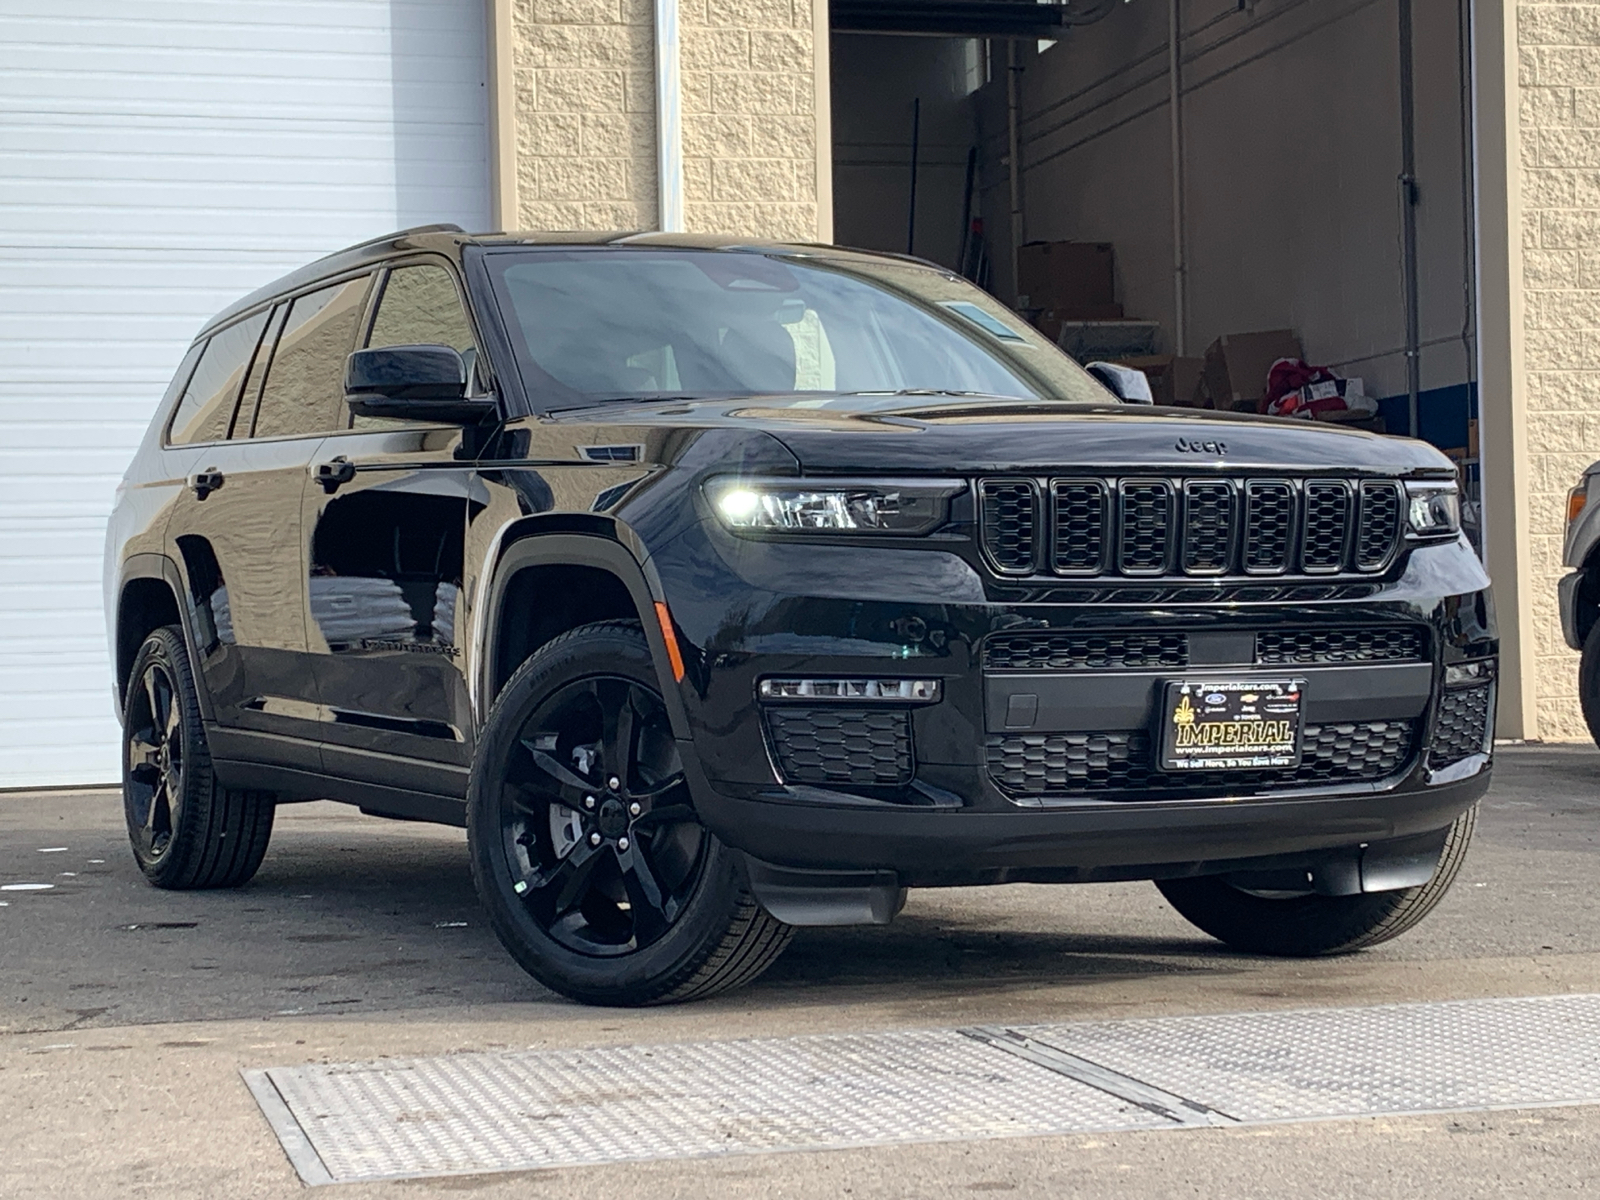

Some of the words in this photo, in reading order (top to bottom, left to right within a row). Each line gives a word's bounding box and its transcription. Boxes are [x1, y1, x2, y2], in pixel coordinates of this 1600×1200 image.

[1175, 437, 1228, 456] Jeep
[1176, 721, 1295, 746] IMPERIAL
[1176, 760, 1189, 768] We
[1238, 758, 1251, 766] You
[1271, 758, 1289, 766] More
